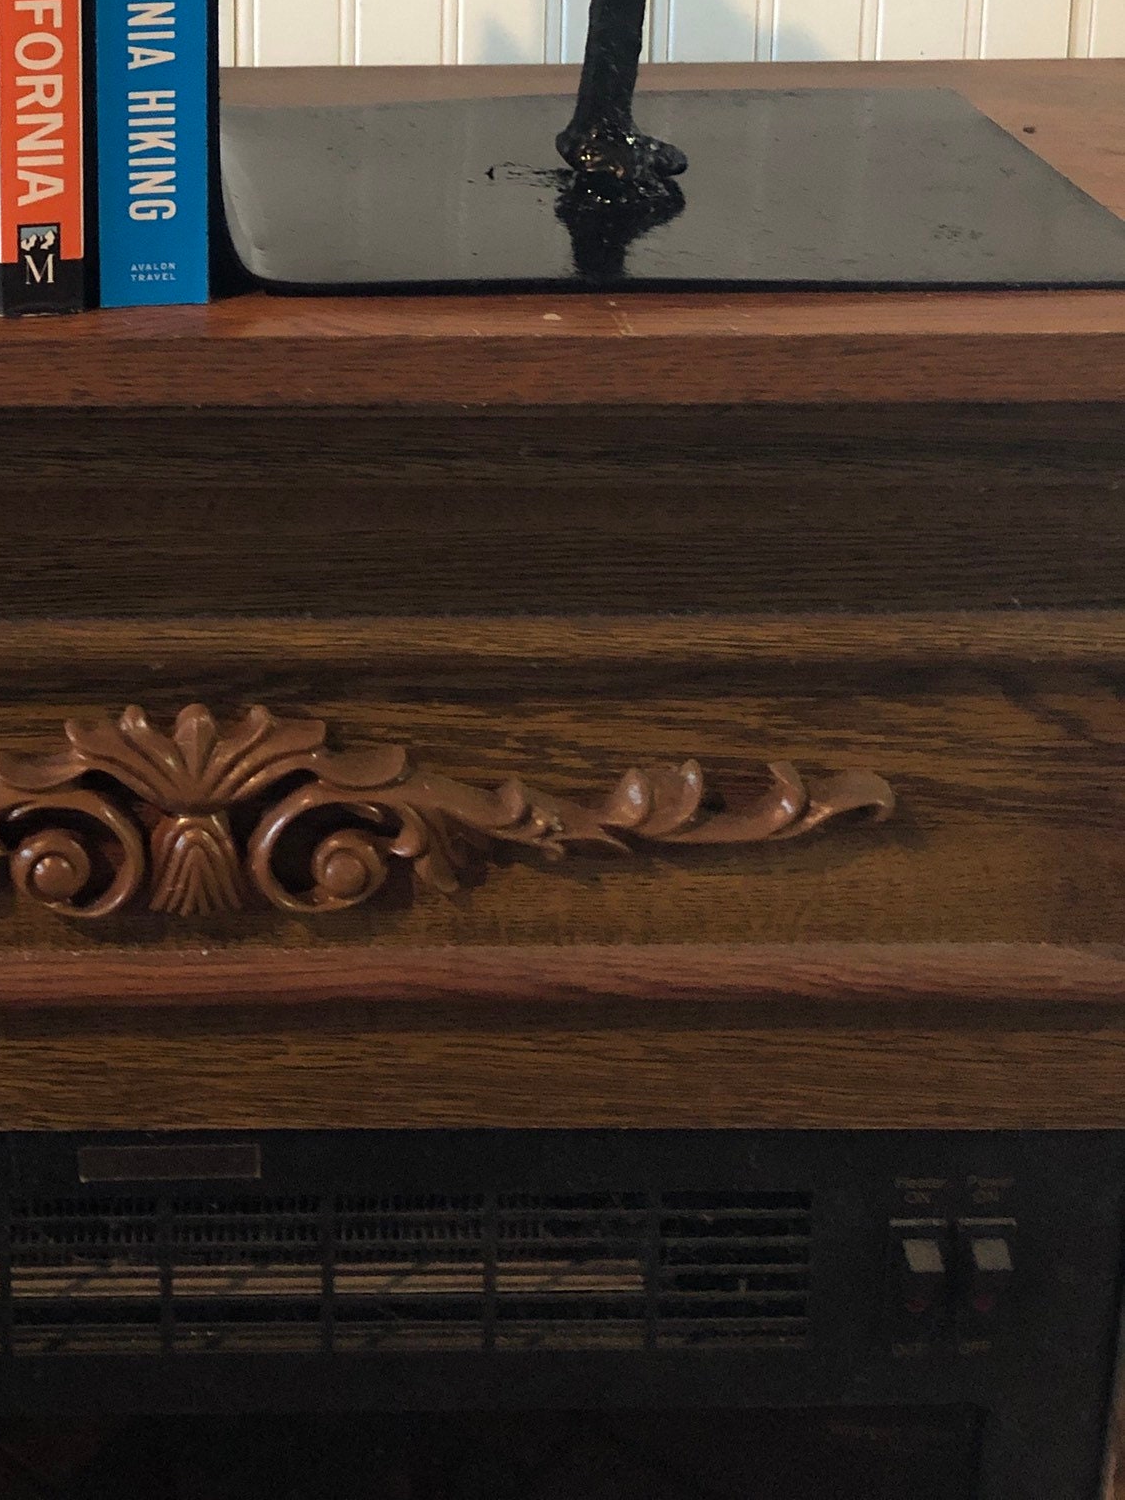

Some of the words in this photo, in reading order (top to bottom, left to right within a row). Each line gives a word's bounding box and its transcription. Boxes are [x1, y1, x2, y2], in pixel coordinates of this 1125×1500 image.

[127, 89, 176, 221] HIKING
[25, 253, 55, 285] M
[130, 262, 176, 272] AVALON
[130, 273, 176, 282] TRAVEL
